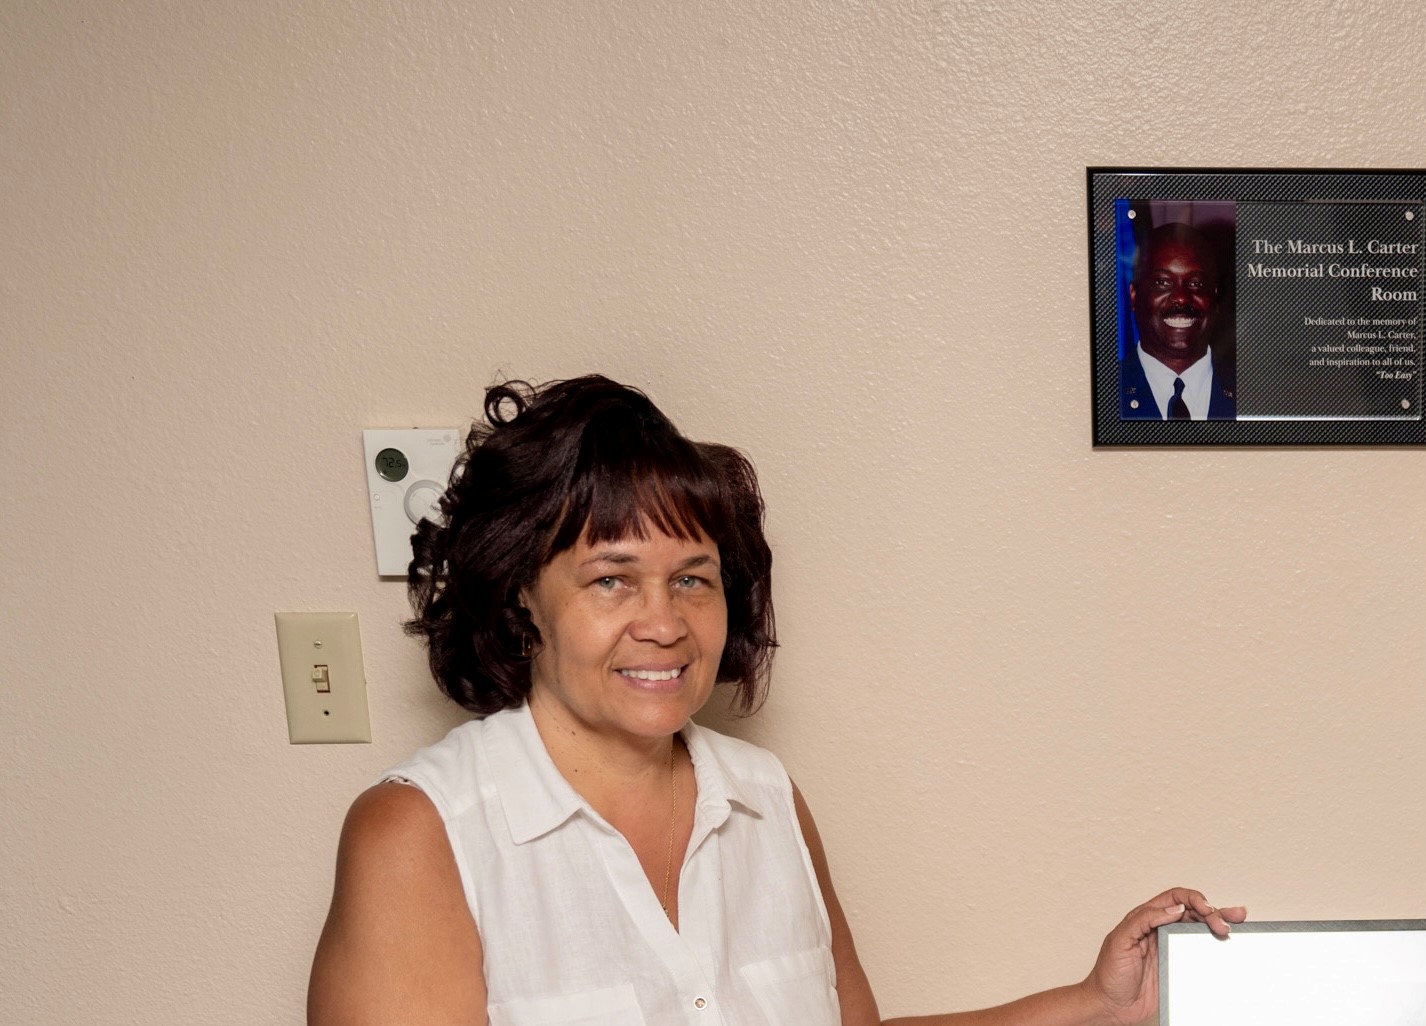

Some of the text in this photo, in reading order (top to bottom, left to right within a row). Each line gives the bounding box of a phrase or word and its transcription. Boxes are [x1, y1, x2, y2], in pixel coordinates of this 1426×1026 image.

[1252, 240, 1419, 254] The Marcus L. Carter
[1248, 264, 1418, 278] Memorial Conference
[1372, 287, 1417, 301] Room
[1305, 317, 1345, 325] Dedicated
[1357, 317, 1370, 325] the
[1372, 319, 1406, 327] memory
[1408, 317, 1417, 325] of
[1347, 331, 1416, 339] Marcus L. Carter,
[1347, 345, 1386, 354] colleague,
[1388, 345, 1416, 353] friend,
[1327, 358, 1370, 368] inspiration
